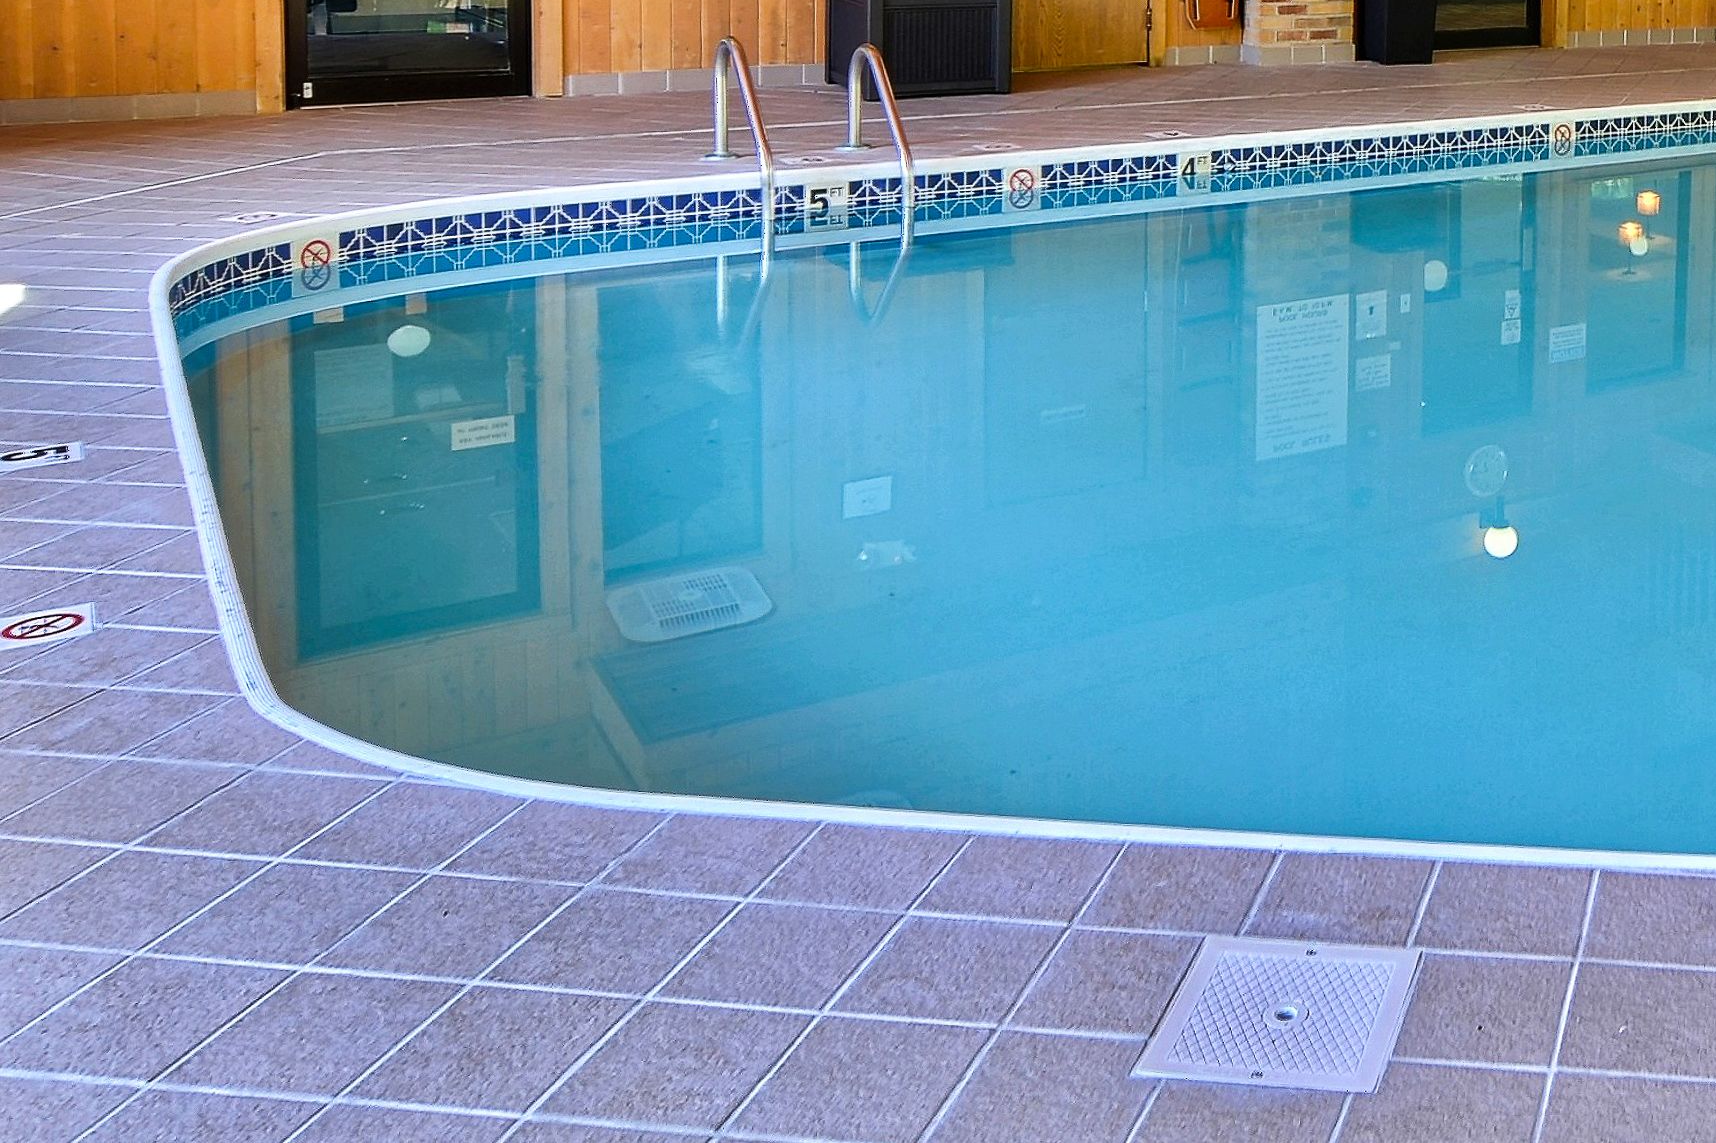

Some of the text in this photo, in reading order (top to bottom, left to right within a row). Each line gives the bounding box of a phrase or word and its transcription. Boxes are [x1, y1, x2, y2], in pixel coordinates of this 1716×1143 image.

[1181, 157, 1196, 176] 4
[810, 186, 844, 216] 5 FT
